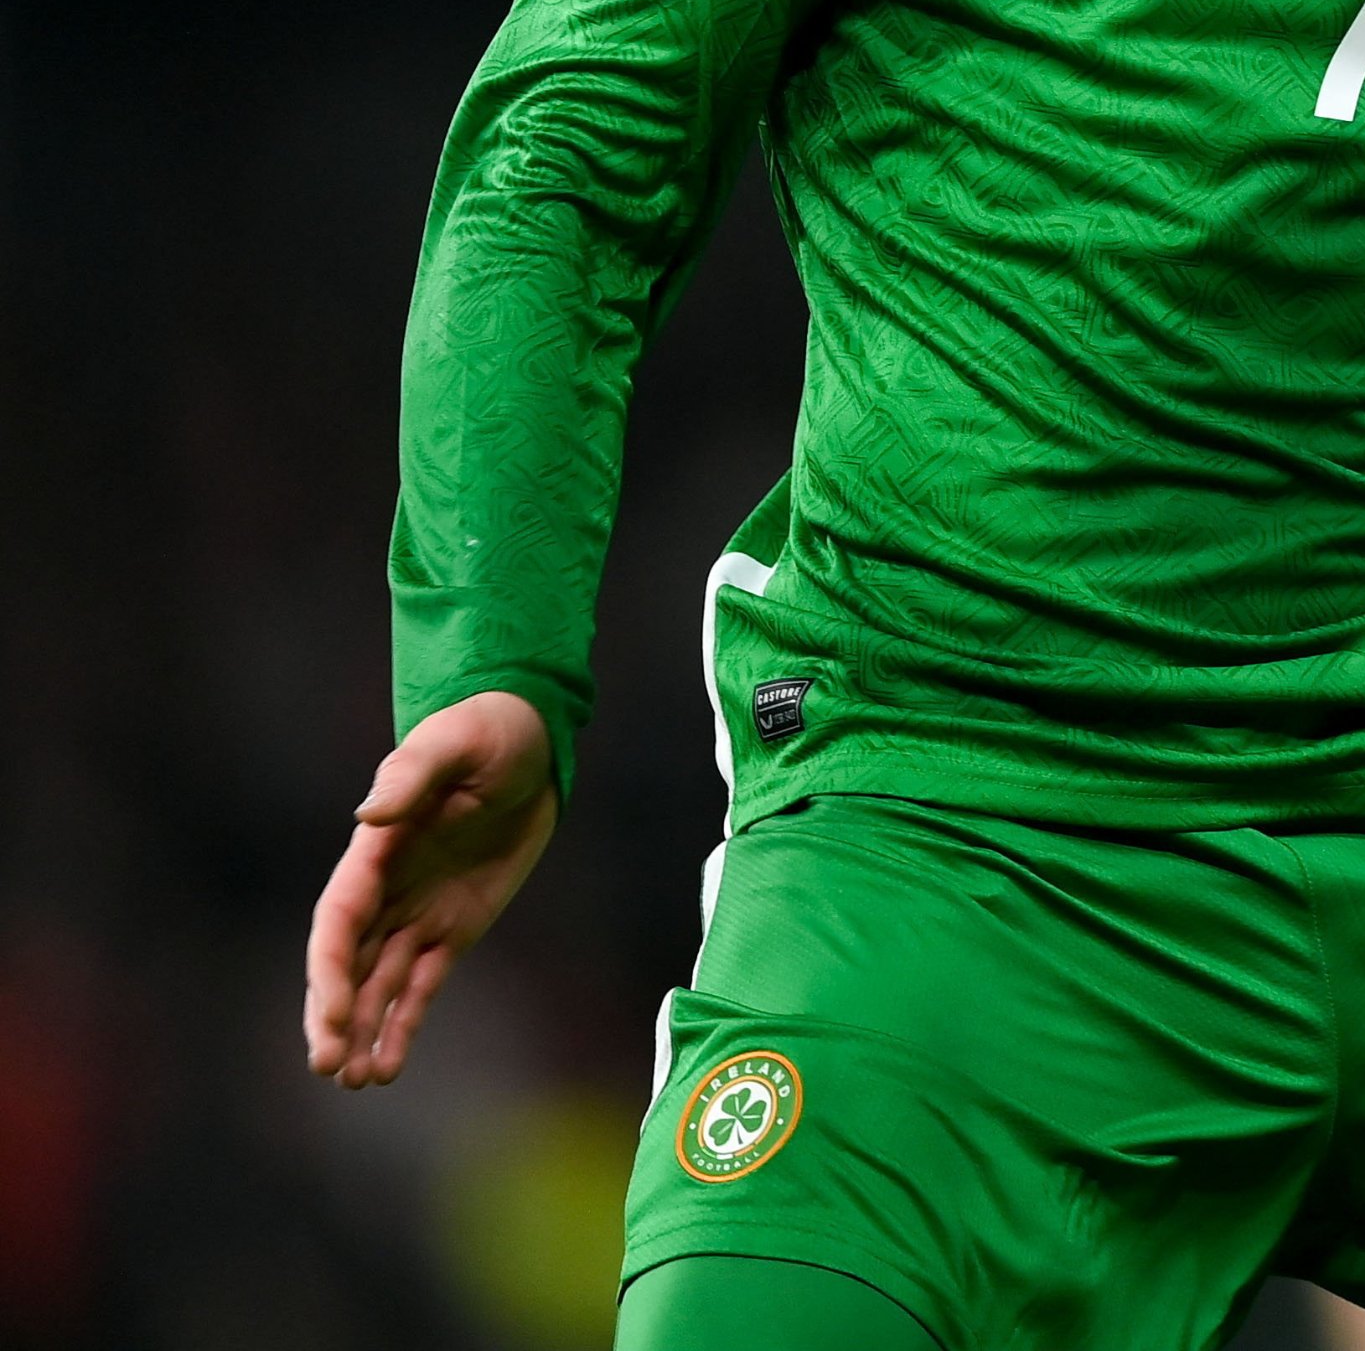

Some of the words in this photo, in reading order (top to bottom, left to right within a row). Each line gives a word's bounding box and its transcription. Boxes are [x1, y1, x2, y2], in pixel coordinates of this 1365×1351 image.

[757, 687, 801, 705] CASTORE
[700, 1061, 791, 1102] IRELAND
[692, 1150, 760, 1172] FOOTBALL
